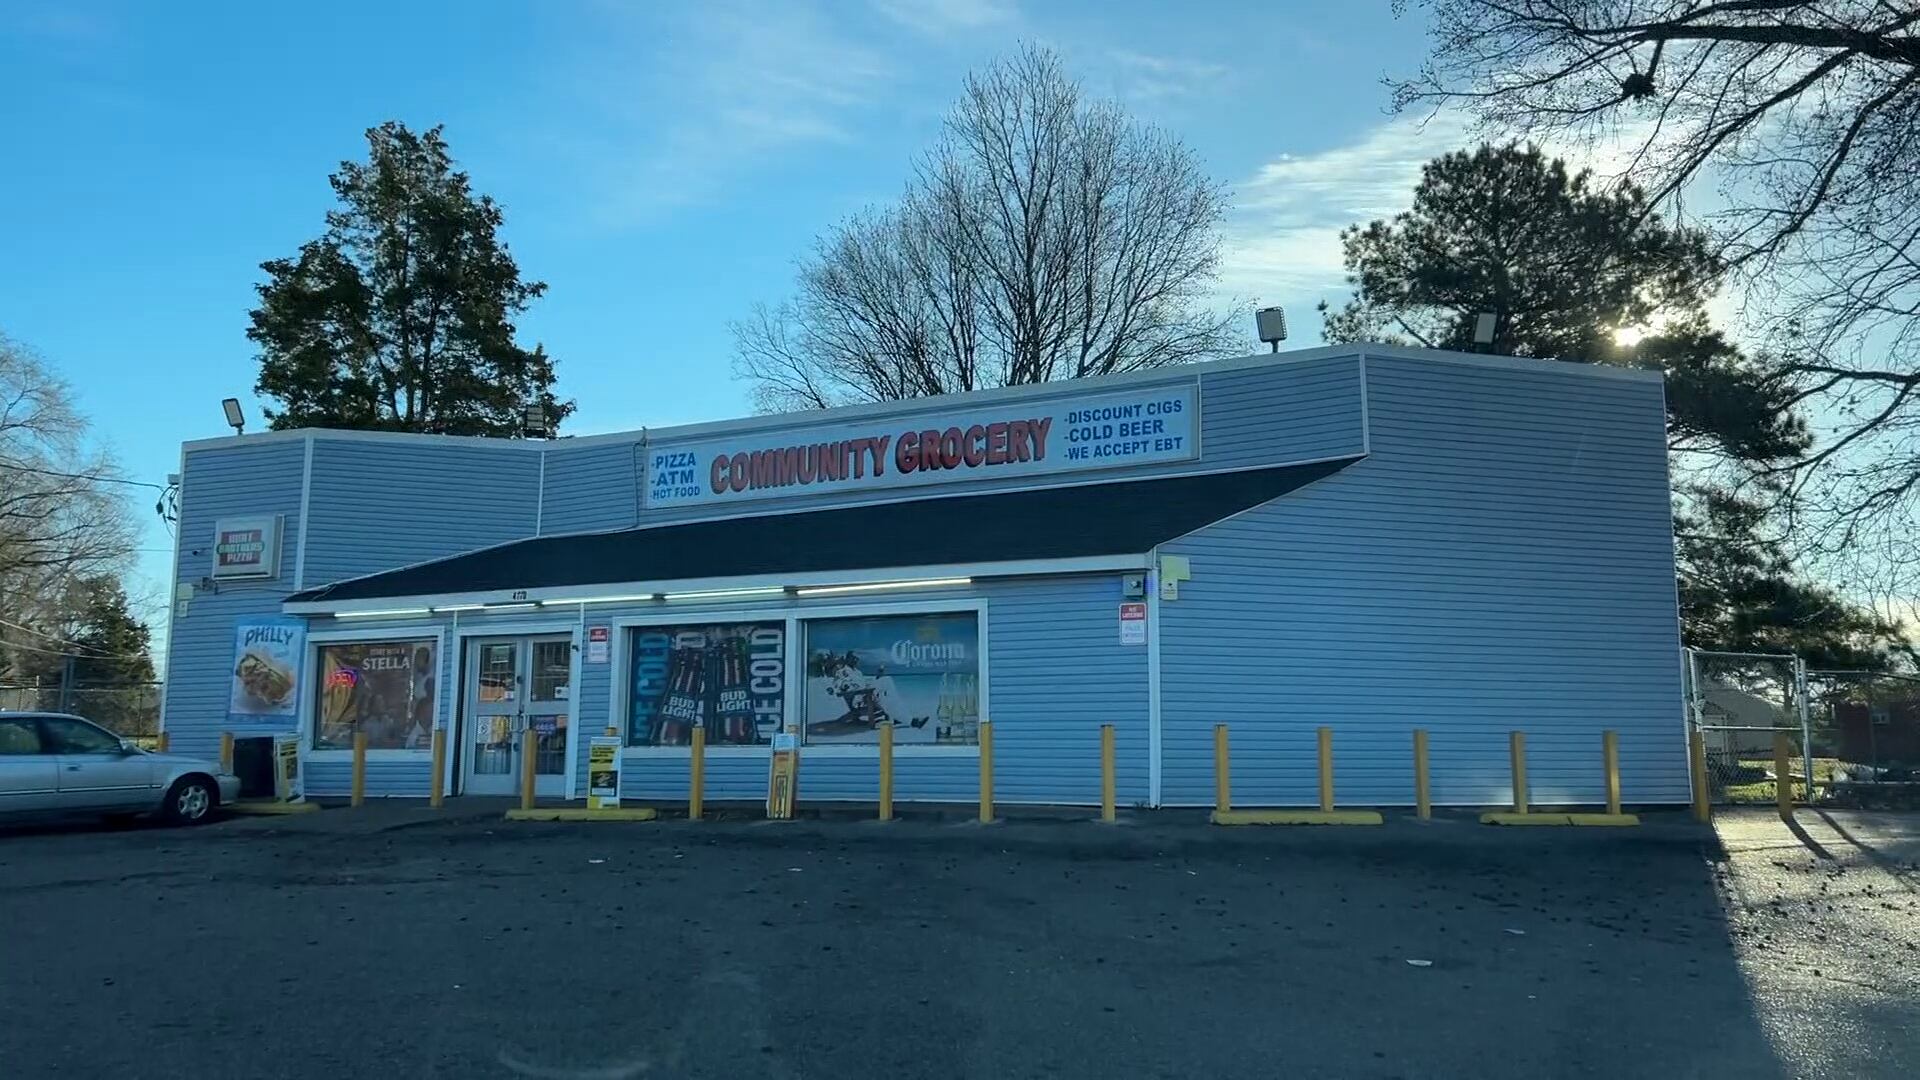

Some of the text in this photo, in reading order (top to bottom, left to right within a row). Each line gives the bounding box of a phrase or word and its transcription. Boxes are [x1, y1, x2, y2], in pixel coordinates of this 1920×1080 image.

[1146, 400, 1183, 416] CIGS
[1119, 419, 1164, 437] BEER
[1093, 441, 1150, 458] ACCEPT
[1154, 436, 1184, 452] EBT
[710, 417, 1053, 495] COMMUNITY GROCERY
[674, 485, 700, 498] FOOD
[751, 629, 784, 694] COLD
[892, 640, 965, 667] Corona
[362, 656, 411, 671] STELLA
[668, 696, 695, 709] BUD
[720, 690, 747, 702] BUD
[662, 704, 697, 721] LIGHT
[716, 700, 751, 713] LIGHT
